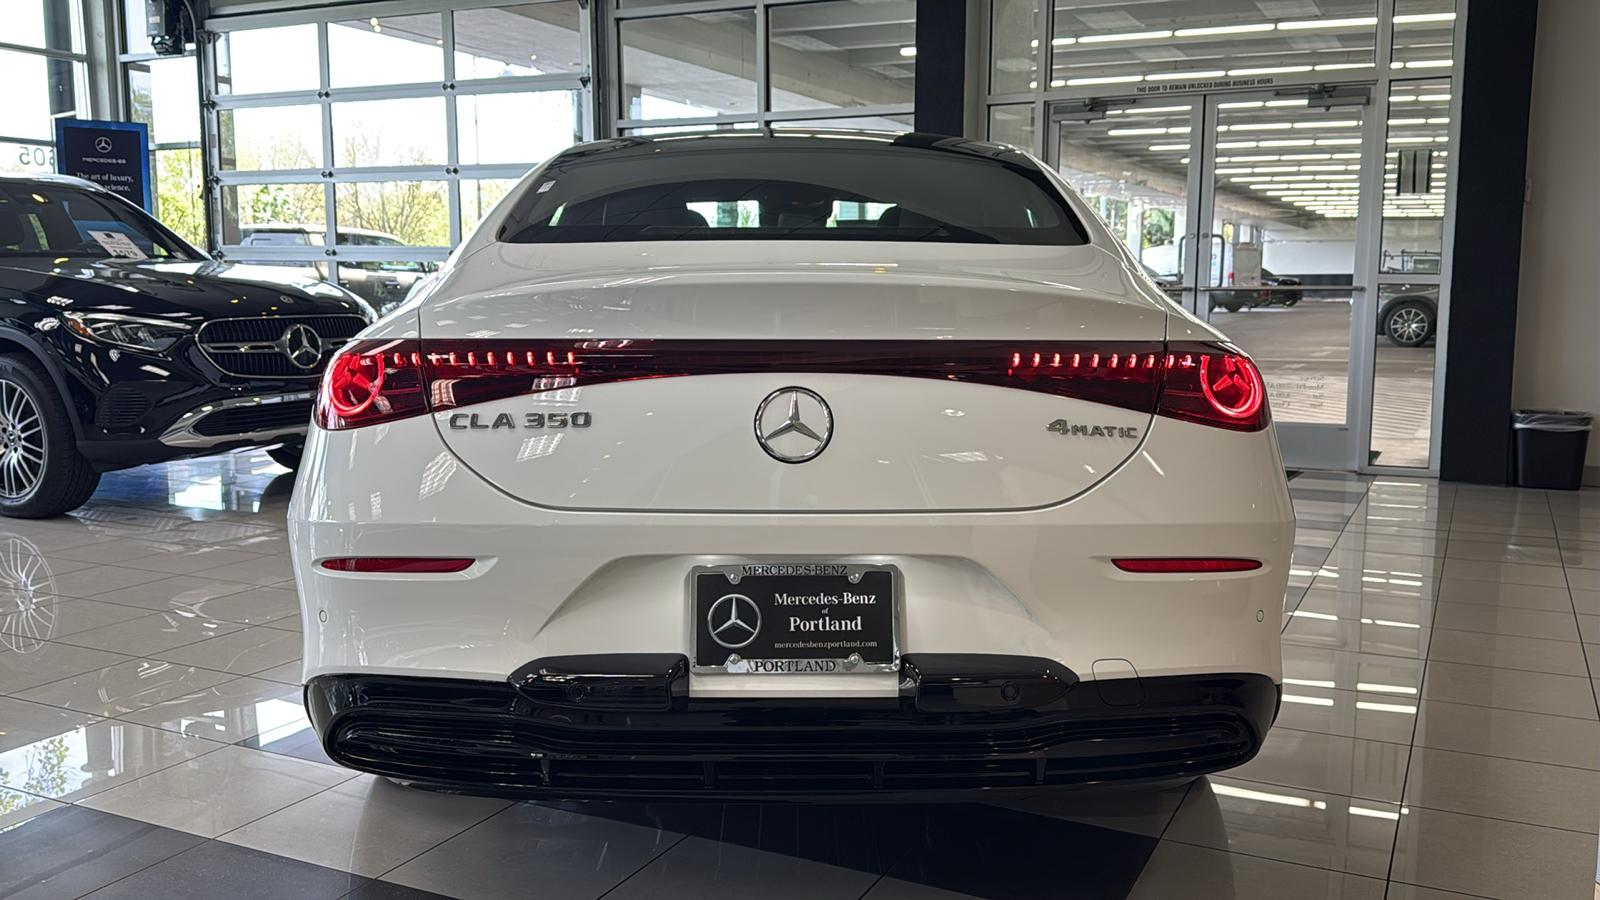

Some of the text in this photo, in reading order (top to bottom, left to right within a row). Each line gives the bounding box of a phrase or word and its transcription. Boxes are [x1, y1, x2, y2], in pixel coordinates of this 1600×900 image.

[1169, 83, 1187, 91] REMAIN
[1187, 81, 1213, 89] UNLOCKED
[1213, 80, 1231, 88] DURING
[1232, 79, 1256, 87] BUSINESS
[1256, 77, 1274, 85] HOURS
[76, 171, 90, 179] The
[102, 173, 109, 181] of
[110, 173, 134, 183] luxury,
[449, 411, 592, 430] CLA 350
[1046, 418, 1138, 439] 4MATIC
[742, 565, 848, 576] MERCEDES-BENZ
[774, 592, 877, 606] Mercedes-Benz
[789, 616, 863, 632] Portland
[774, 640, 878, 650] mercedesbenzportland.com
[753, 660, 837, 673] PORTLAND
